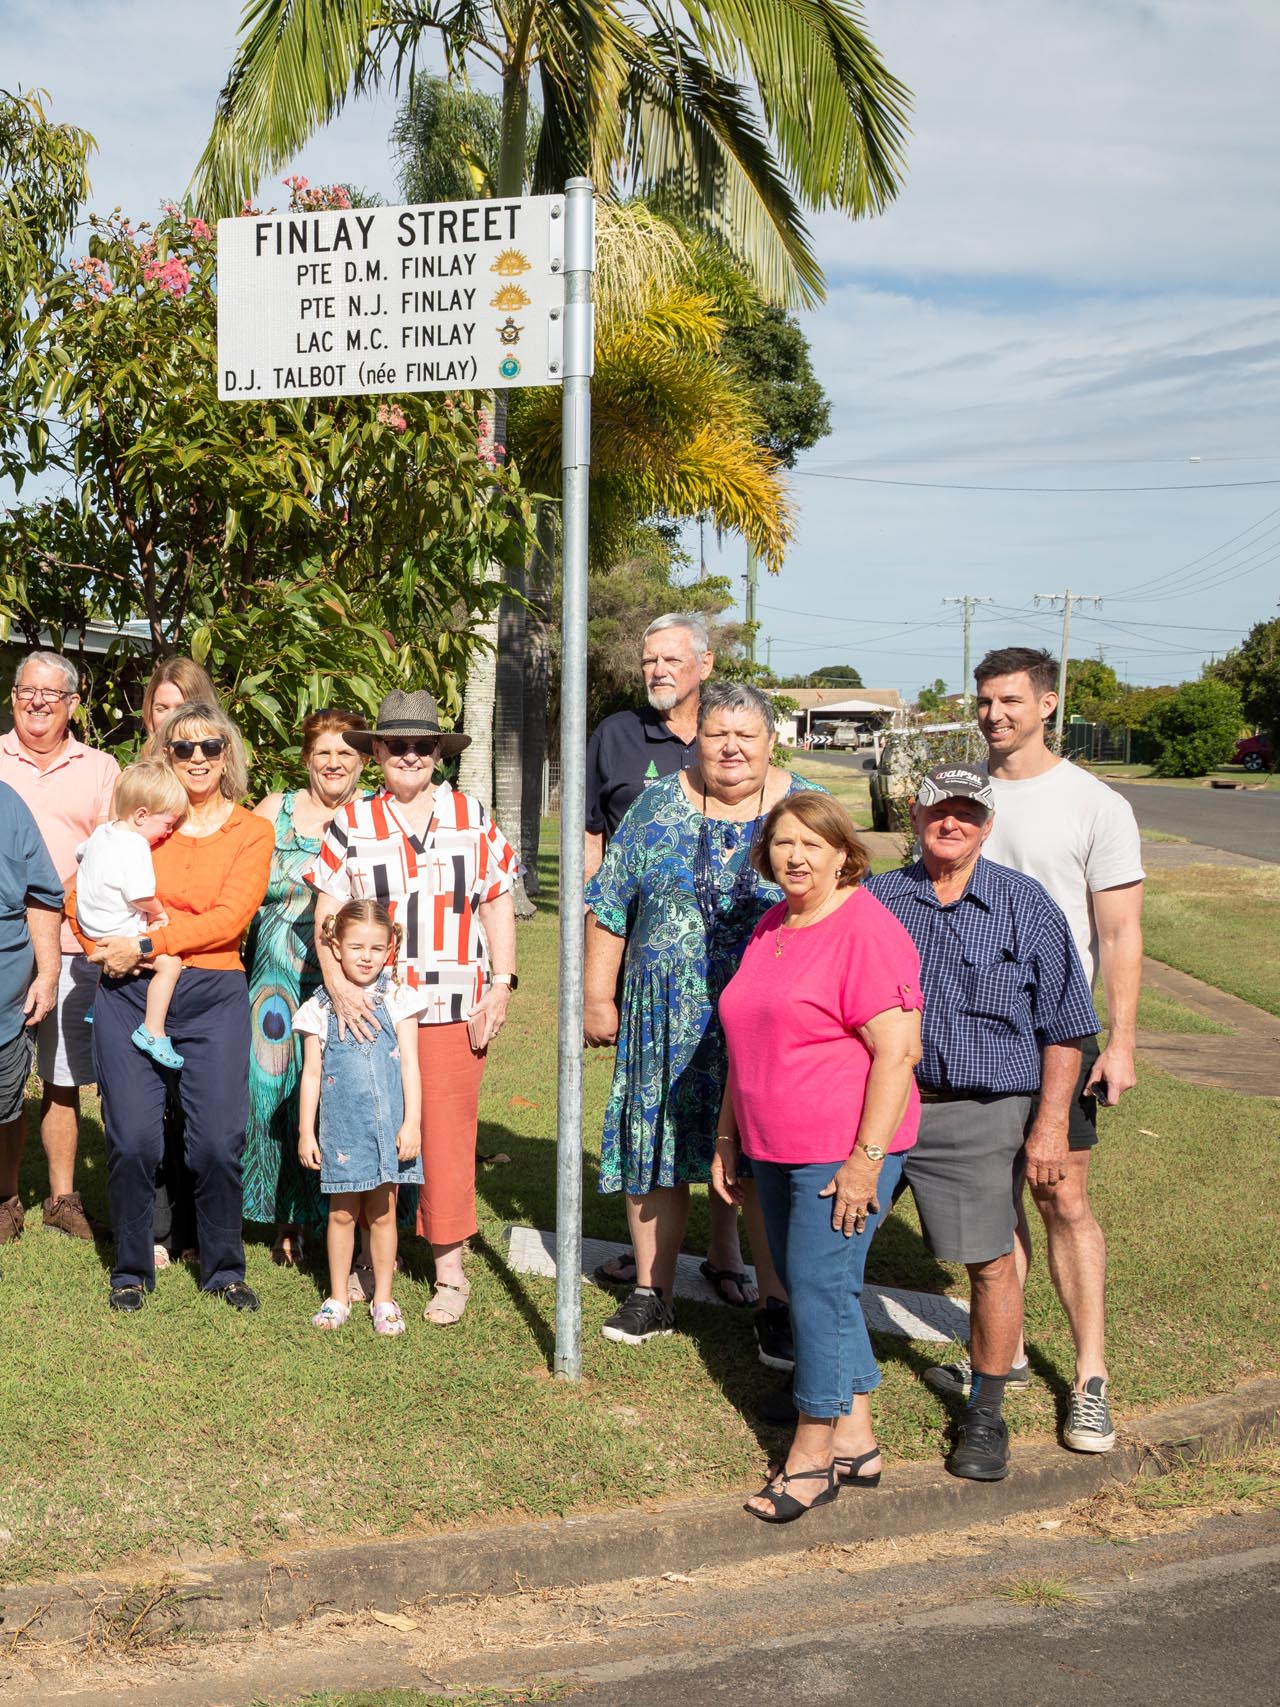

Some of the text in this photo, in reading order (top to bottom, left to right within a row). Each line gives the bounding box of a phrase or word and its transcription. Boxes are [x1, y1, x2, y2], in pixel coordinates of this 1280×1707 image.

[256, 204, 522, 257] FINLAY STREET
[297, 253, 477, 286] PTE D.M. FINLAY
[300, 288, 477, 320] PTE N.J. FINLAY
[296, 322, 476, 354] LAC M.C. FINLAY
[225, 355, 478, 392] D.J. TALBOT (née FINLAY)
[946, 769, 983, 784] CLIPSAL
